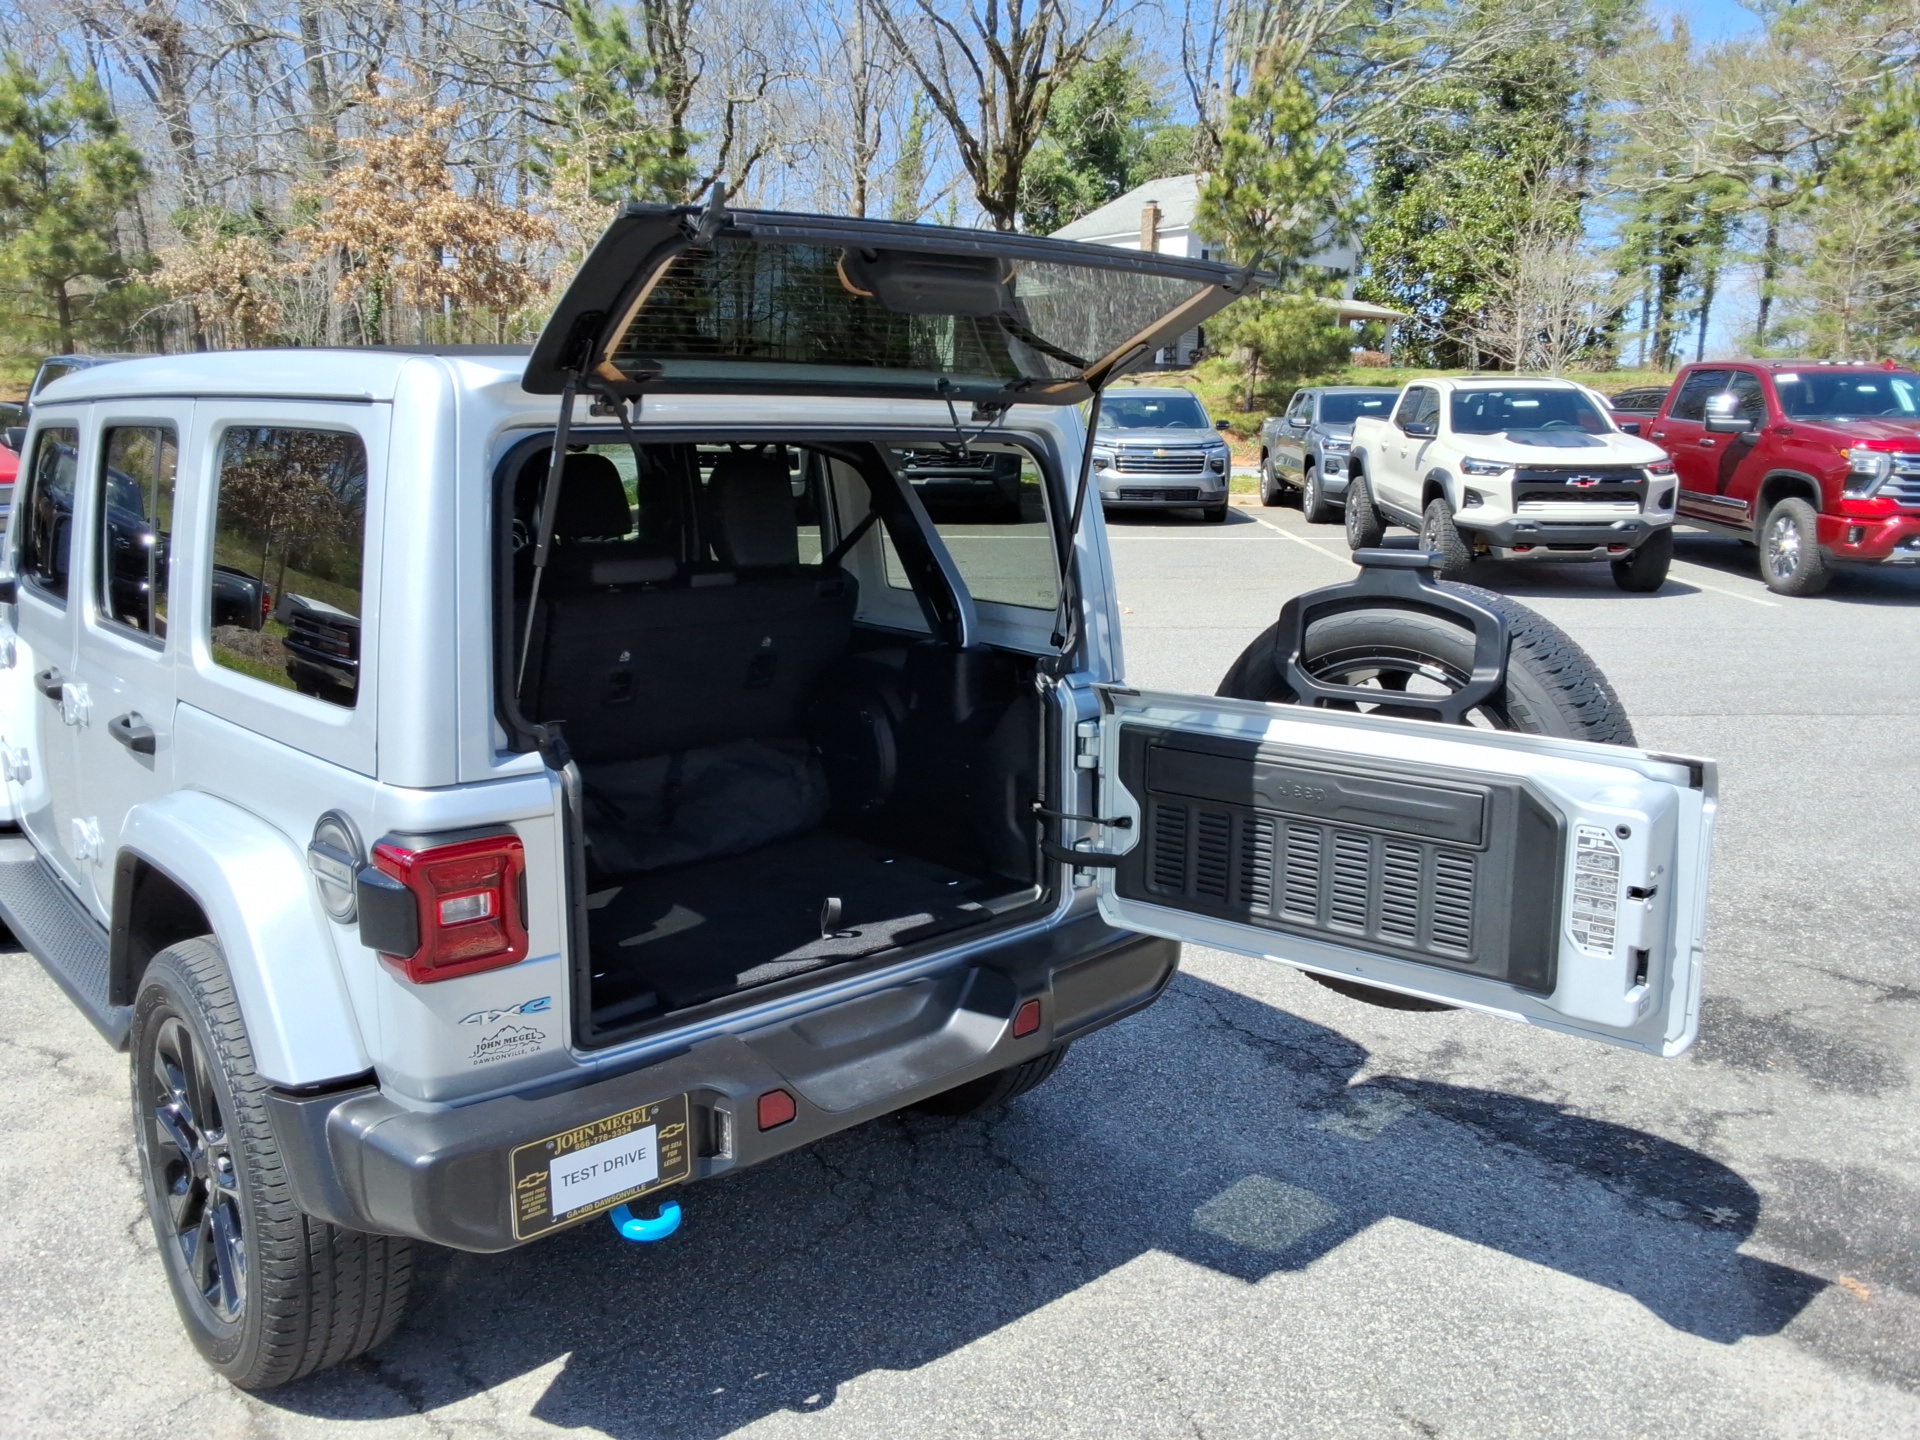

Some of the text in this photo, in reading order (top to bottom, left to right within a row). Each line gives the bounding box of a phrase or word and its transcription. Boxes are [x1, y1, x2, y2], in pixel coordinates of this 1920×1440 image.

[1279, 779, 1328, 805] Jeep
[473, 1045, 541, 1066] DAWSONVILLE, GA
[476, 1032, 537, 1055] JOHN MEGEL
[554, 1108, 651, 1155] JOHN MEGEL
[561, 1148, 647, 1187] TEST DRIVE
[594, 1184, 647, 1209] DAWSONVILLE
